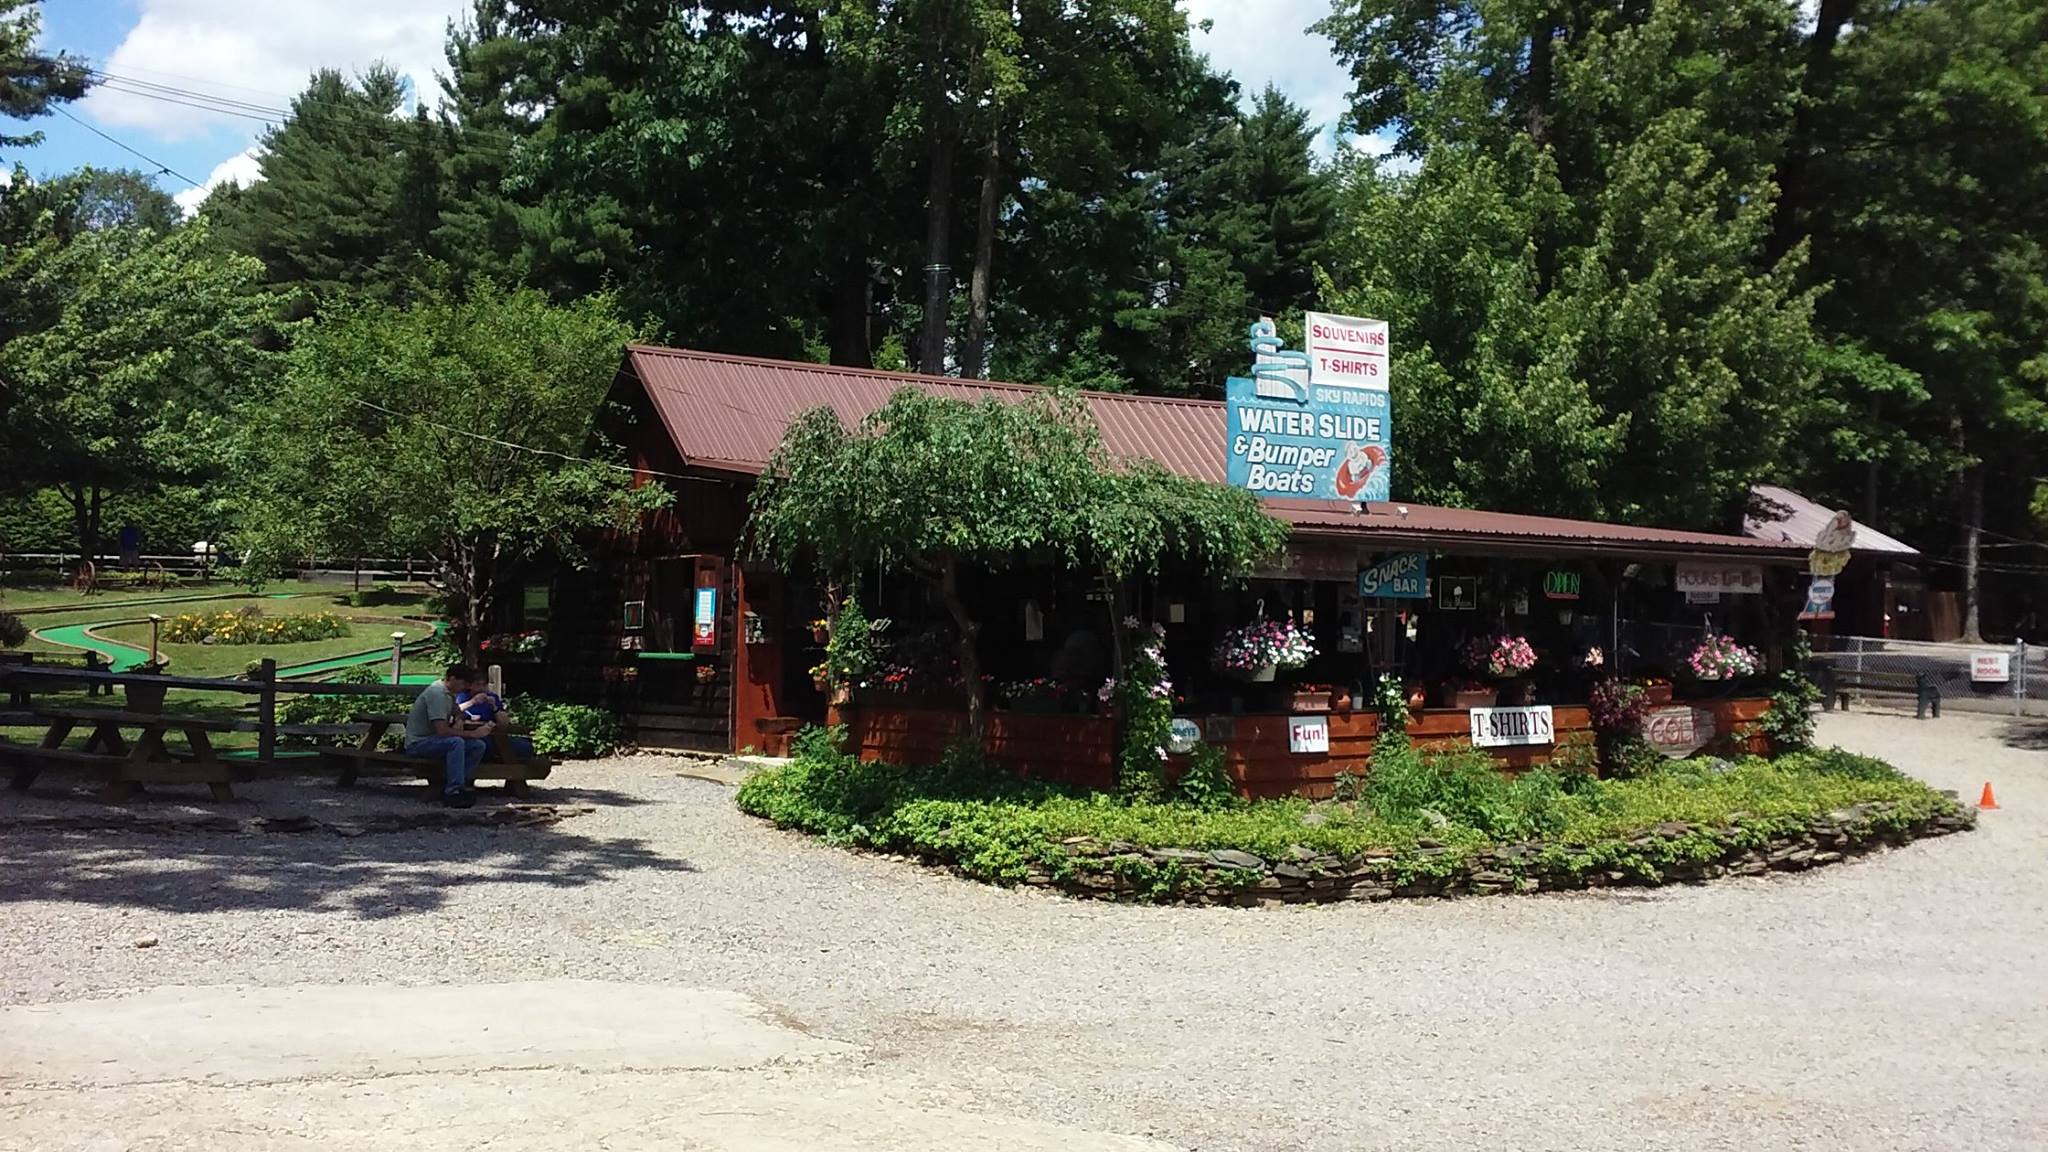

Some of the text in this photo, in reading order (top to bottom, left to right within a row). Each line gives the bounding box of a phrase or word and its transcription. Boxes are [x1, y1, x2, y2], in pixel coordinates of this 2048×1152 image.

[1312, 324, 1385, 346] SOUVENIRS
[1320, 358, 1378, 376] T-SHIRTS
[1315, 388, 1386, 407] SKY RAPIDS
[1238, 407, 1381, 441] WATER SLIDE
[1233, 435, 1335, 470] & Bumper
[1247, 464, 1315, 493] Boats
[1363, 555, 1419, 594] SNACK
[1393, 578, 1418, 593] BAR
[1543, 571, 1581, 594] OPEN
[1293, 724, 1325, 741] Fun!
[1473, 711, 1549, 737] T-SHIRTS
